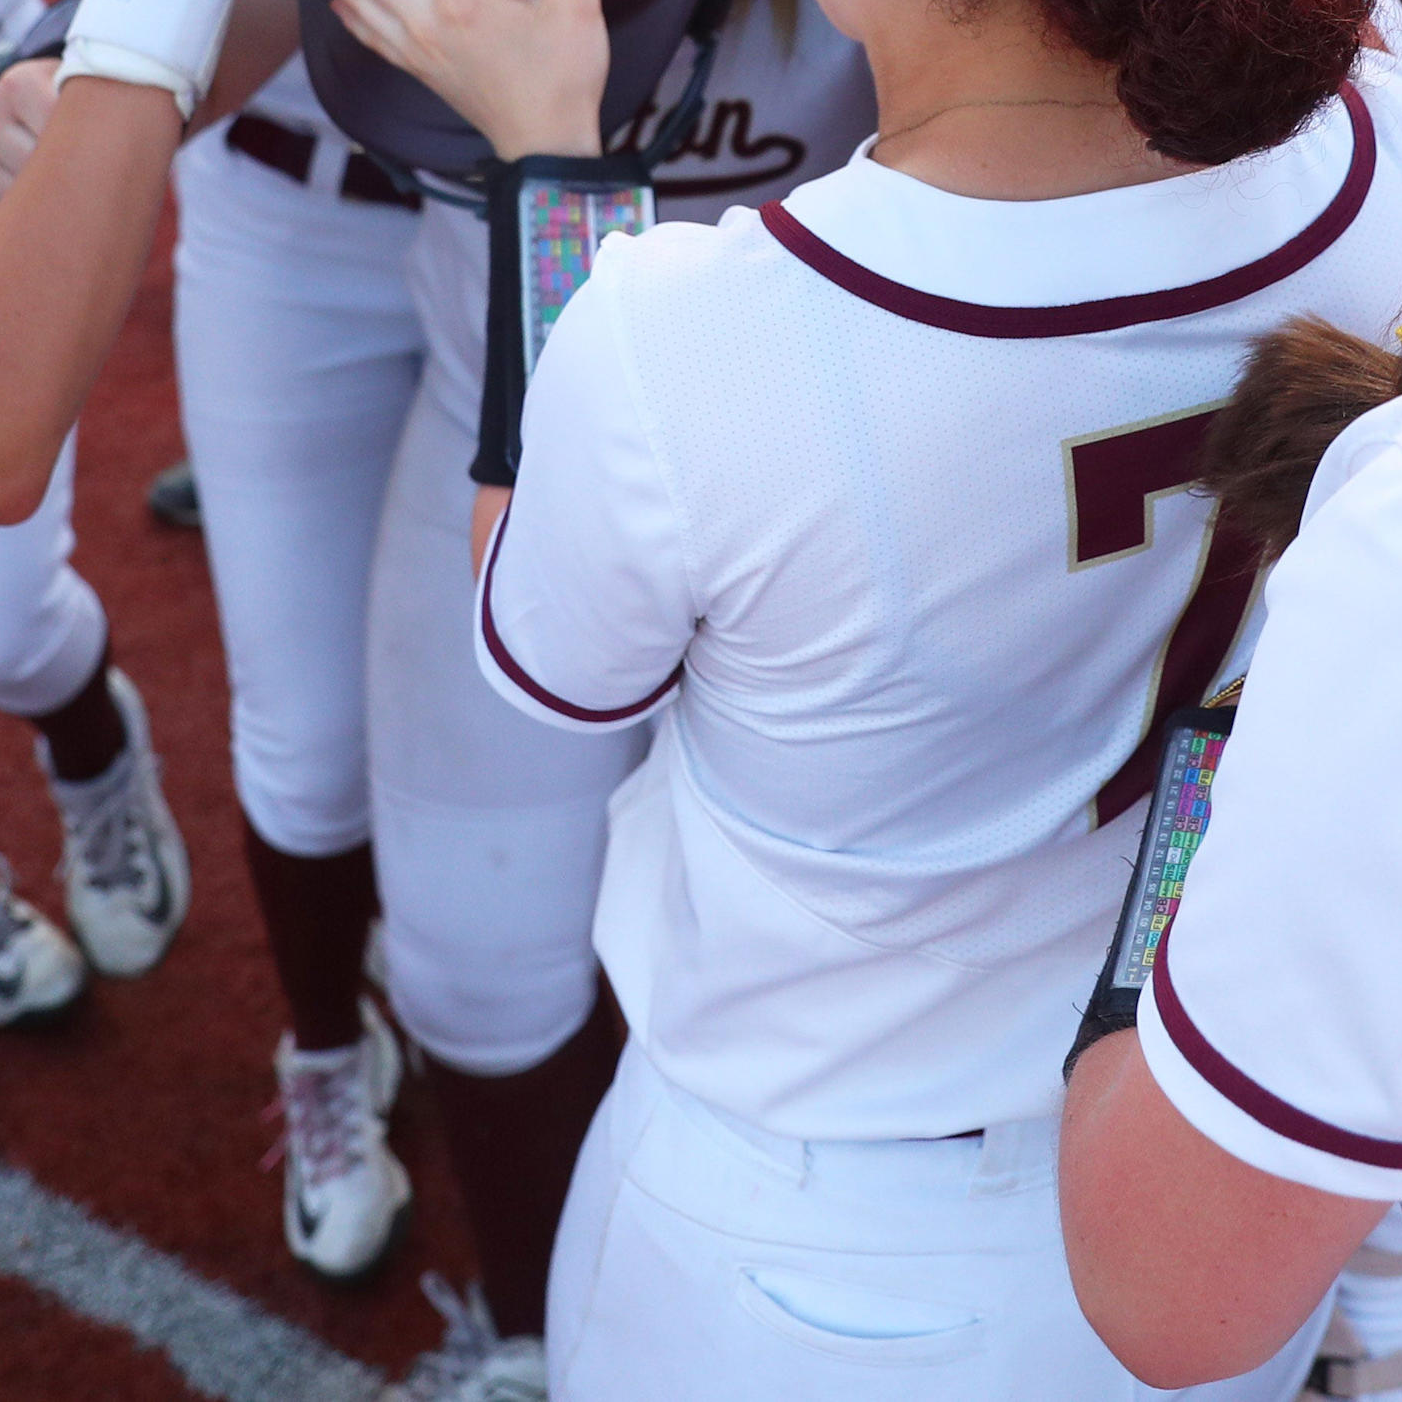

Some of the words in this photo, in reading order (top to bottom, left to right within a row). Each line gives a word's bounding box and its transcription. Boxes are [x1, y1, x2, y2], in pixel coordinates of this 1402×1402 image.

[1060, 397, 1270, 834] 7
[1189, 818, 1199, 830] CB
[1201, 772, 1209, 783] FBI
[1176, 816, 1186, 829] CB
[1132, 952, 1140, 961] 01
[1136, 935, 1143, 943] 02
[1156, 850, 1165, 858] 12
[1153, 916, 1163, 929] FBI
[1157, 899, 1167, 912] CB
